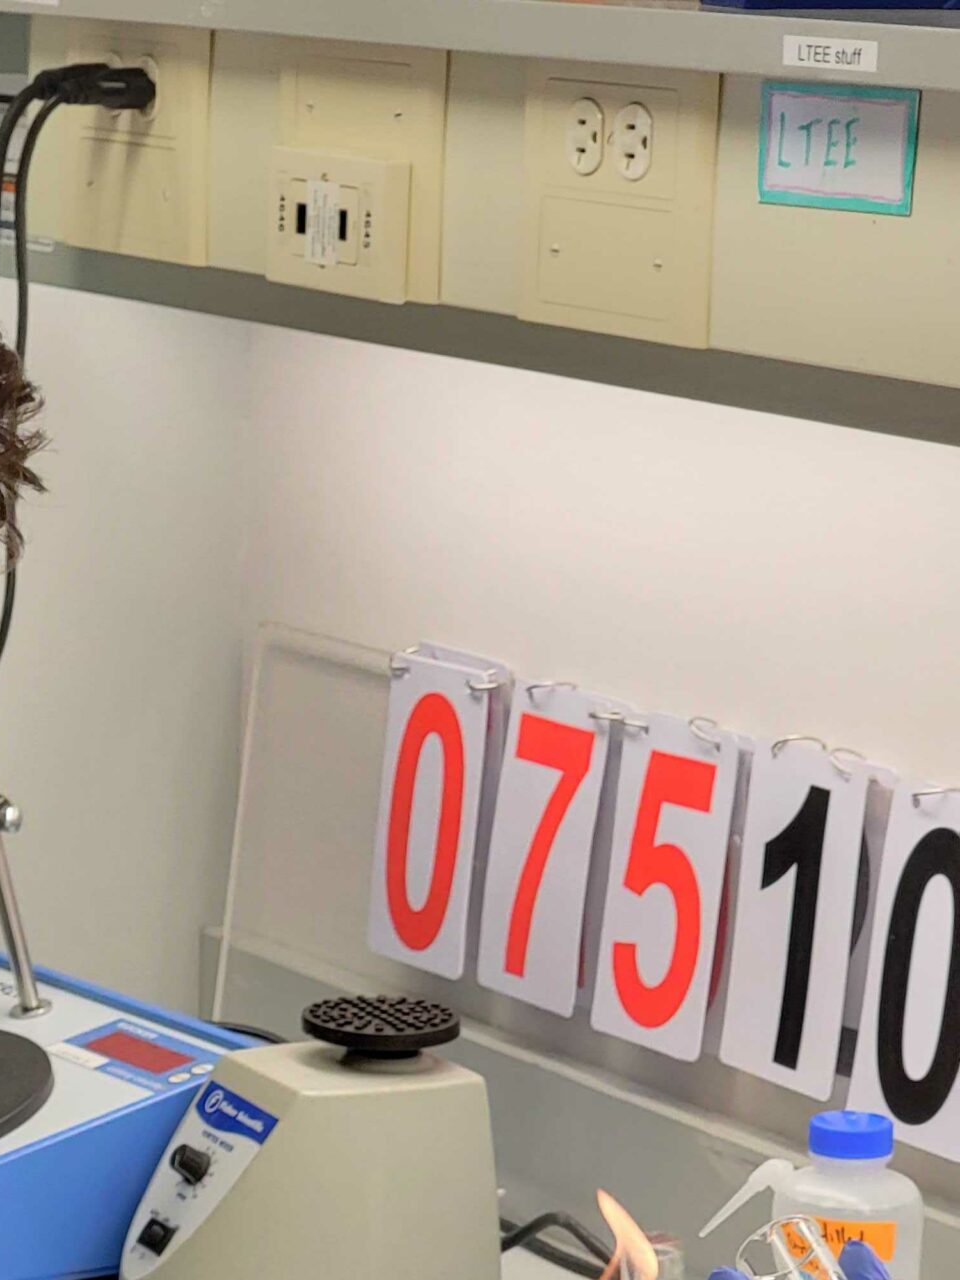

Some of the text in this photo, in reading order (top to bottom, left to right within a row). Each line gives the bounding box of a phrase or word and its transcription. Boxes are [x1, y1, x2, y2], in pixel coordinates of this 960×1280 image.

[797, 43, 863, 66] LTEE stuff
[777, 111, 860, 169] LTEE
